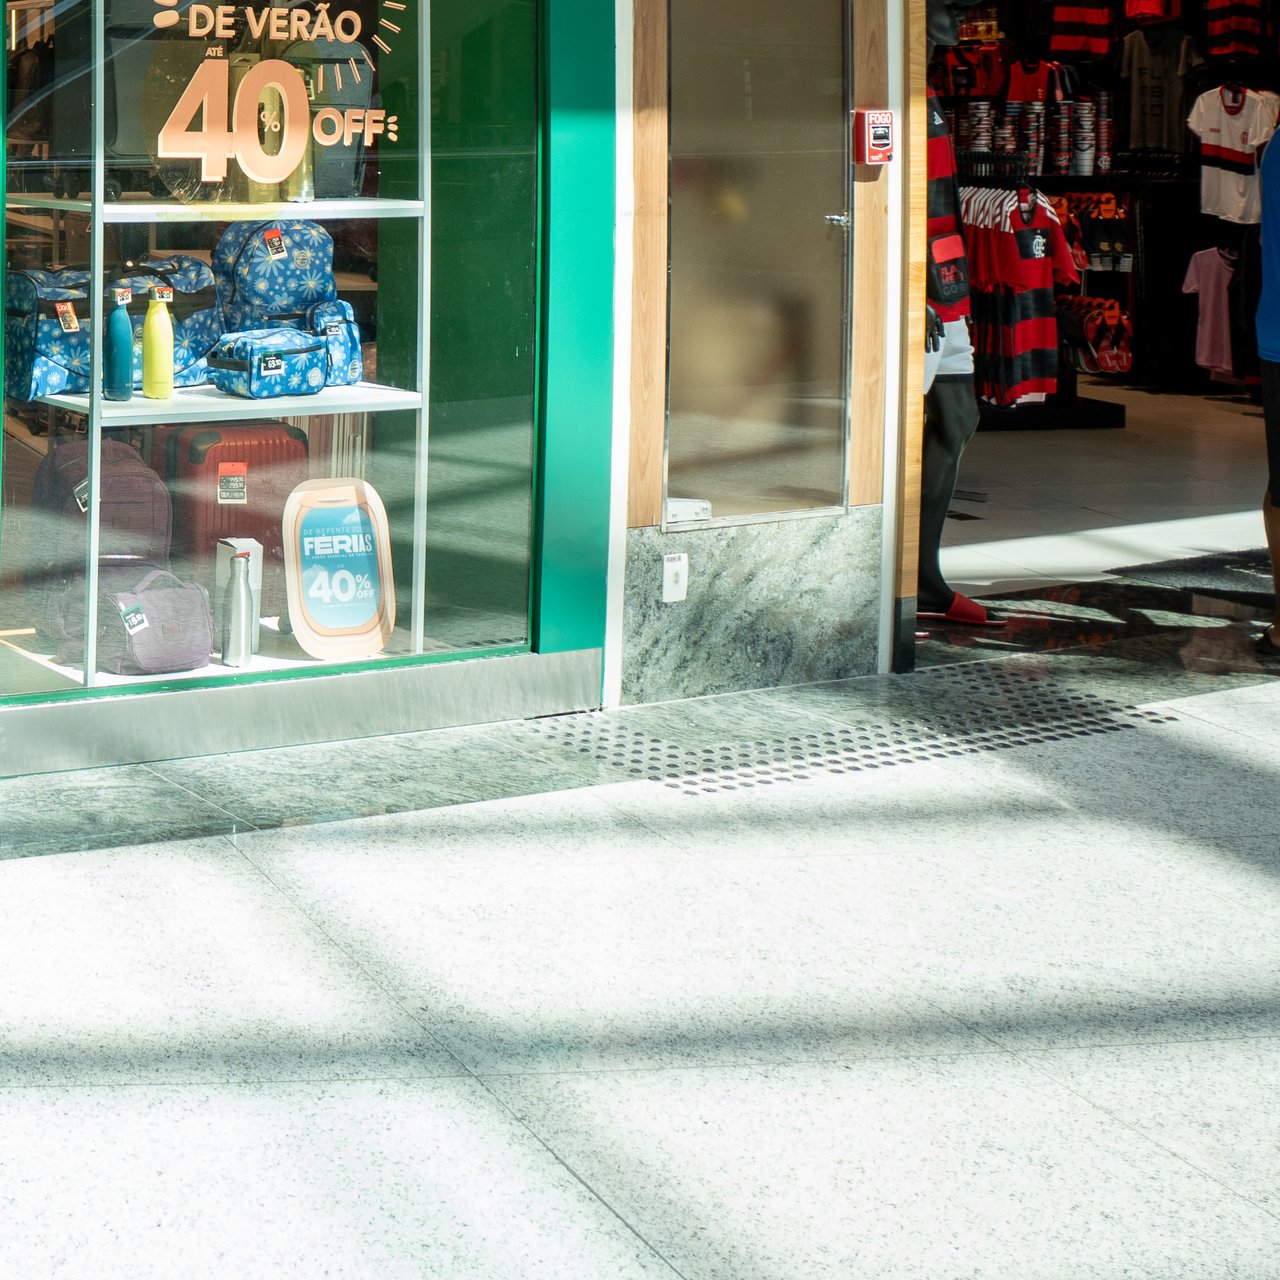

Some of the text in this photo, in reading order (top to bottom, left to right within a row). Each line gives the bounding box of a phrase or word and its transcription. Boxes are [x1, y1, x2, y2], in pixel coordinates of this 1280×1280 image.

[189, 2, 362, 44] DE VERÃO
[205, 46, 224, 57] ATÉ
[869, 113, 892, 124] FOGO
[312, 107, 385, 146] OFF
[304, 528, 313, 536] DE
[315, 526, 350, 536] REPENTE
[303, 534, 372, 556] FÉRIAS
[356, 589, 375, 599] OFF
